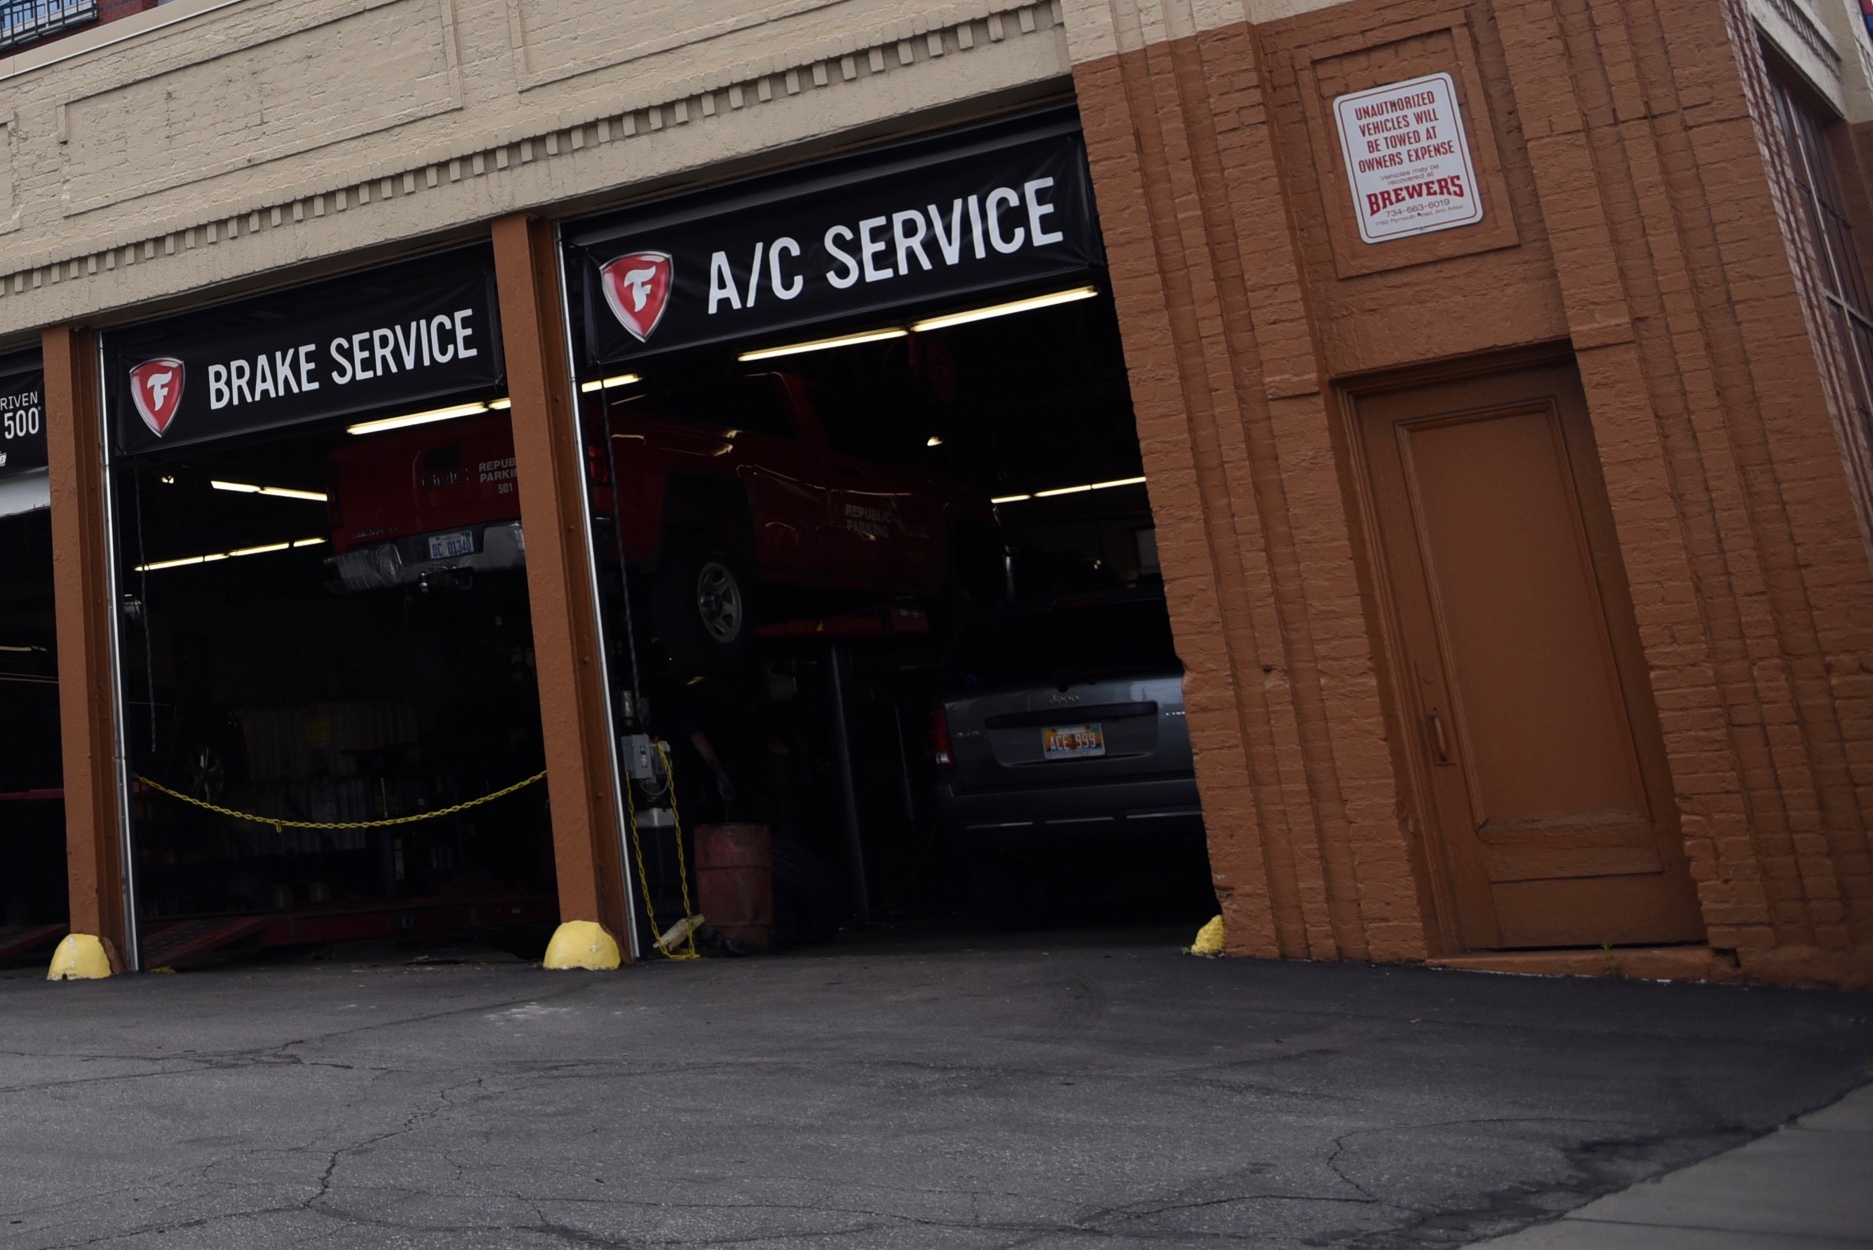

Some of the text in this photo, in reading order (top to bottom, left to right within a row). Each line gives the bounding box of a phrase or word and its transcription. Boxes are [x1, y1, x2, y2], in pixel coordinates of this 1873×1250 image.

[1355, 91, 1435, 121] UNAUTHORIZED
[1359, 108, 1439, 137] VEHICLES WILL
[1366, 126, 1438, 154] BE TOWED AT
[1358, 140, 1455, 173] OWNERS EXPENSE
[1379, 170, 1411, 182] Vehicles
[1412, 166, 1428, 176] may
[1387, 173, 1425, 186] recovered
[1365, 174, 1465, 217] BREWER'S
[1385, 198, 1451, 218] 734-663-6019
[707, 176, 1064, 315] A/C SERVICE
[208, 308, 478, 410] BRAKE SERVICE
[3, 406, 40, 439] 500
[497, 482, 513, 495] 501
[845, 503, 891, 524] REPUBLIC
[1049, 733, 1097, 751] ACE 999
